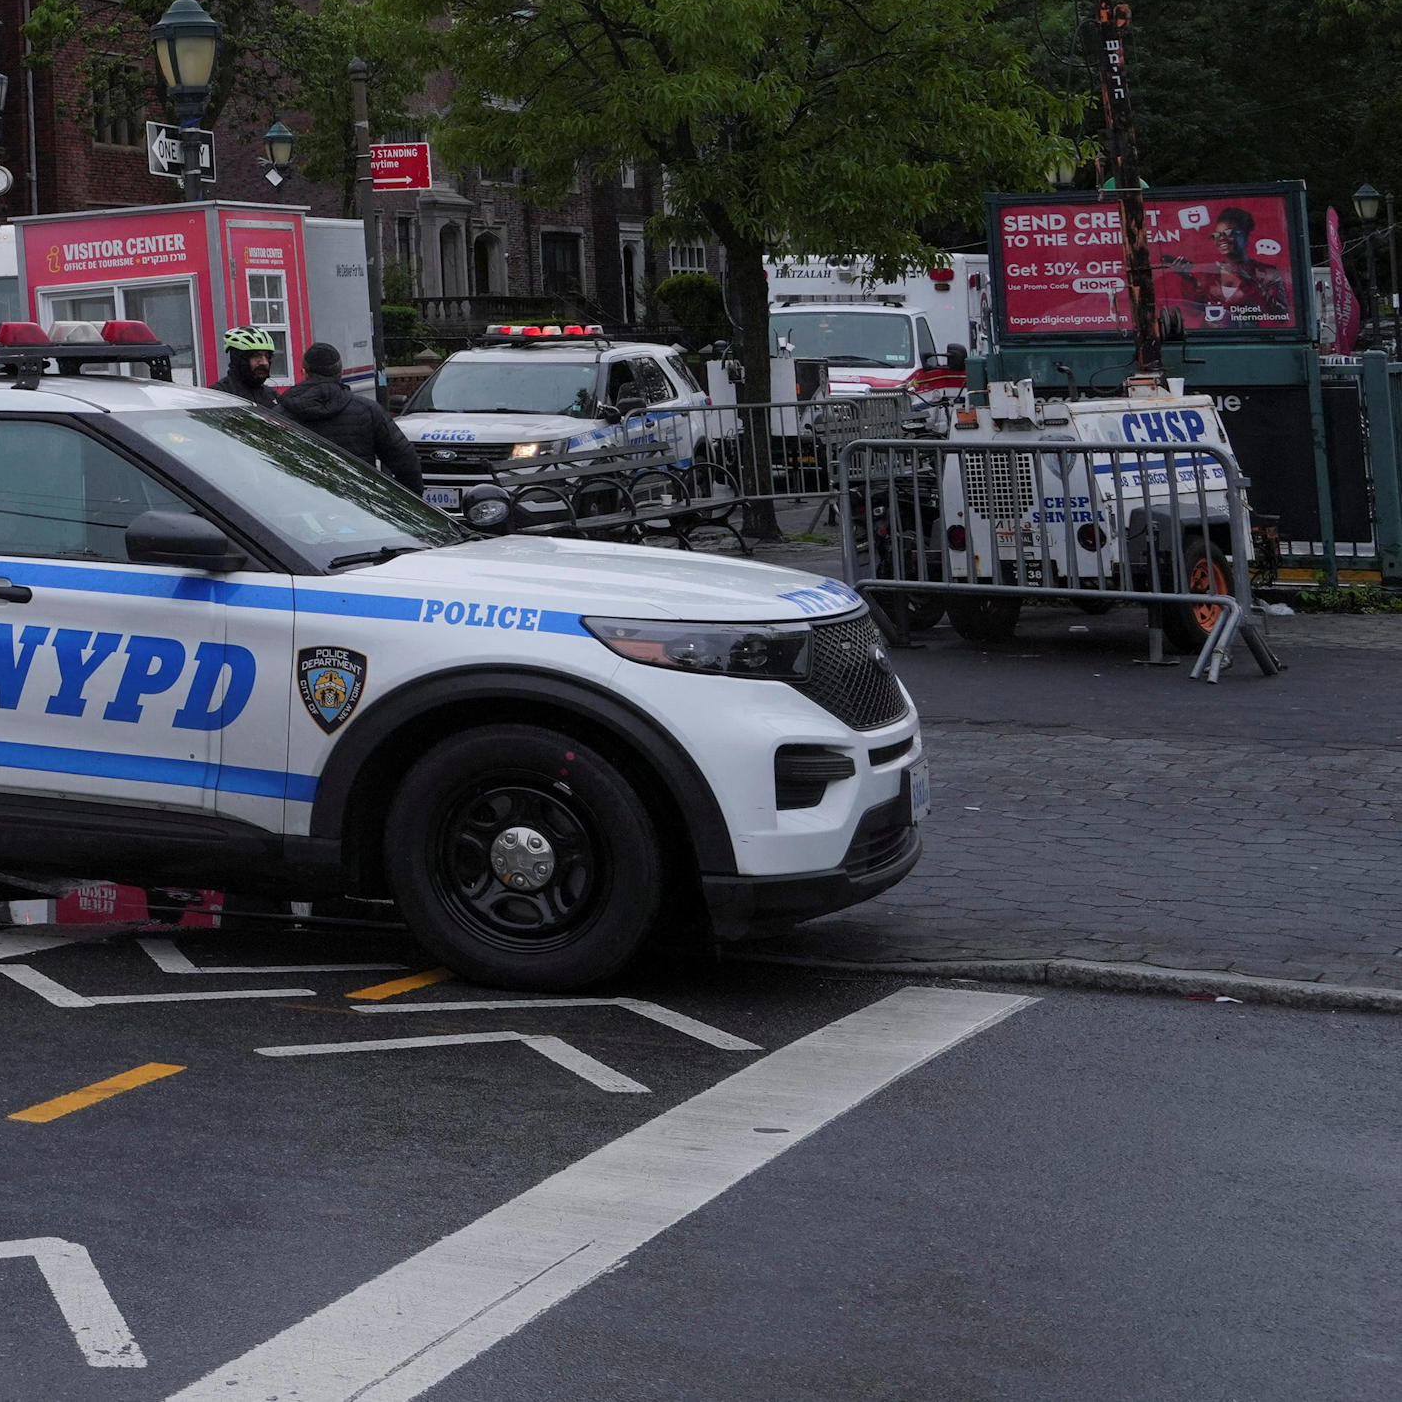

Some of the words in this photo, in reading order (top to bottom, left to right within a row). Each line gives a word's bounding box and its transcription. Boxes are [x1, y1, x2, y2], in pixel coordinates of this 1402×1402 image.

[1105, 39, 1126, 99] שמירה
[159, 140, 177, 160] ONE
[378, 149, 418, 158] STANDING
[370, 160, 399, 170] nytime
[1004, 214, 1067, 232] SEND
[1074, 209, 1160, 230] CRET
[63, 238, 125, 261] VISITOR
[126, 233, 186, 255] CENTER
[1005, 235, 1029, 247] TO
[1033, 233, 1068, 247] THE
[1074, 229, 1181, 246] CARIEAN
[64, 262, 87, 272] OFFICE
[88, 261, 96, 270] DE
[98, 258, 134, 269] TOURISME
[1007, 263, 1038, 277] Get
[1044, 262, 1079, 276] 30%
[1086, 261, 1123, 275] OFF
[1023, 283, 1047, 291] Promo
[1080, 280, 1117, 291] HOME
[1230, 305, 1262, 314] Digicel
[1230, 312, 1290, 322] International
[1122, 409, 1205, 442] CHSP
[421, 433, 476, 441] POLICE
[423, 599, 538, 631] POLICE
[316, 648, 349, 660] POLICE
[302, 658, 362, 676] DEPARTMENT
[300, 679, 312, 702] CITY
[308, 703, 319, 716] OF
[338, 703, 353, 722] NEW
[350, 681, 362, 703] YORK
